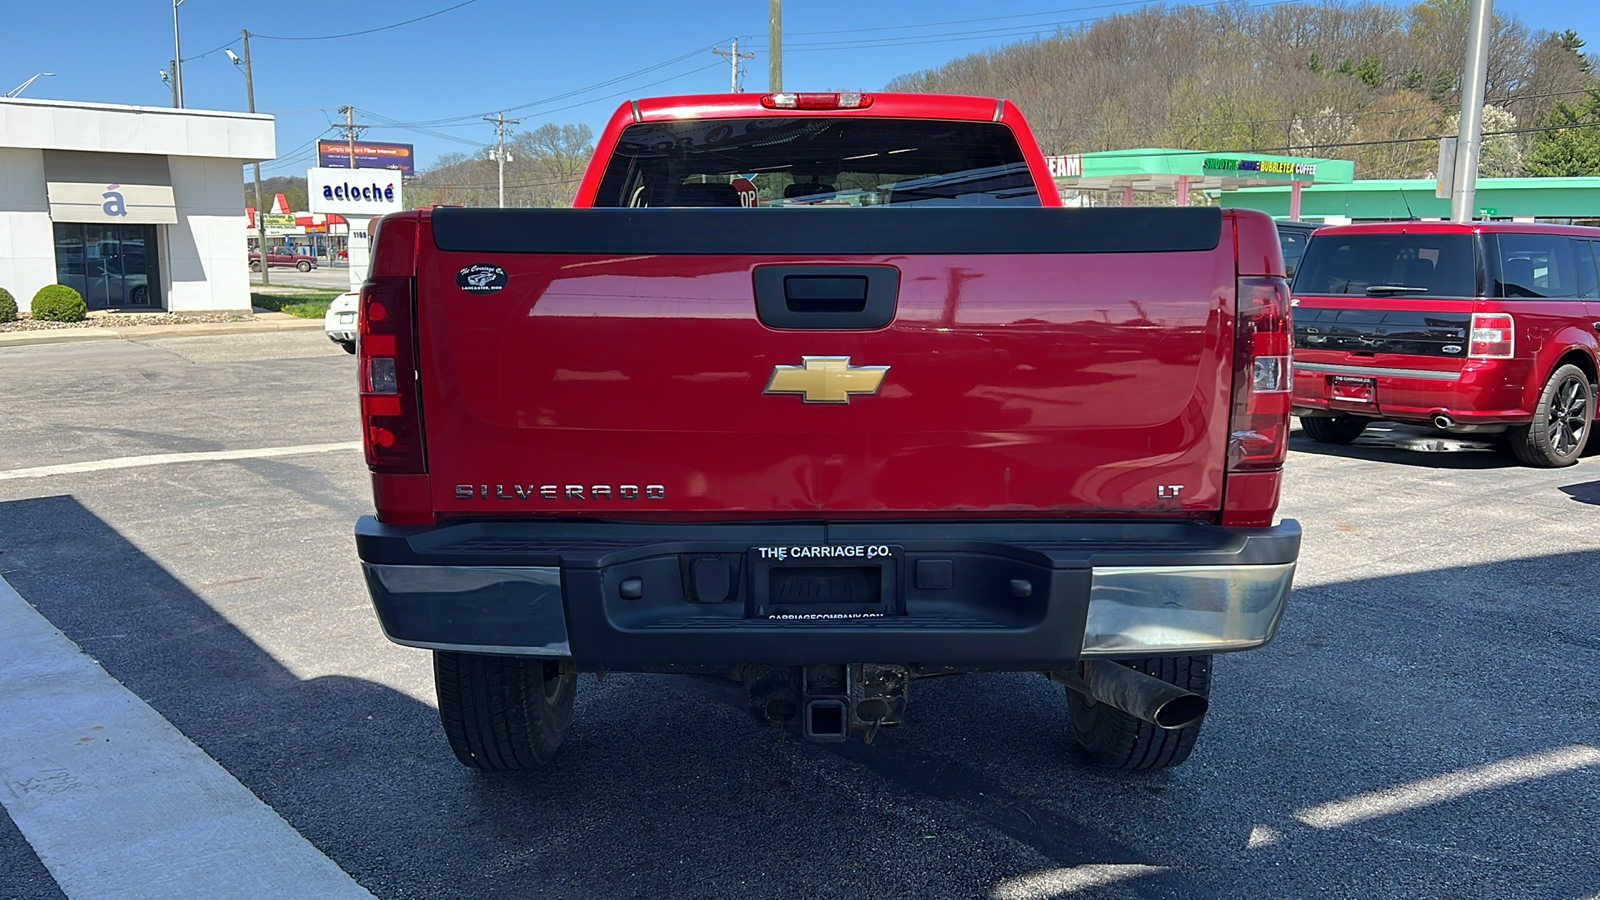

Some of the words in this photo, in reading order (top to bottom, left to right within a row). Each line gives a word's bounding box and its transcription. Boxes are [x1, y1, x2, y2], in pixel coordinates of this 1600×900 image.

[1045, 158, 1080, 177] EAM
[1295, 163, 1316, 175] COFFEE
[323, 182, 394, 199] acloché
[455, 484, 665, 500] SILVERADO
[1157, 484, 1184, 499] LT
[759, 547, 787, 558] THE
[790, 546, 864, 558] CARRIAGE
[869, 545, 892, 557] CO.
